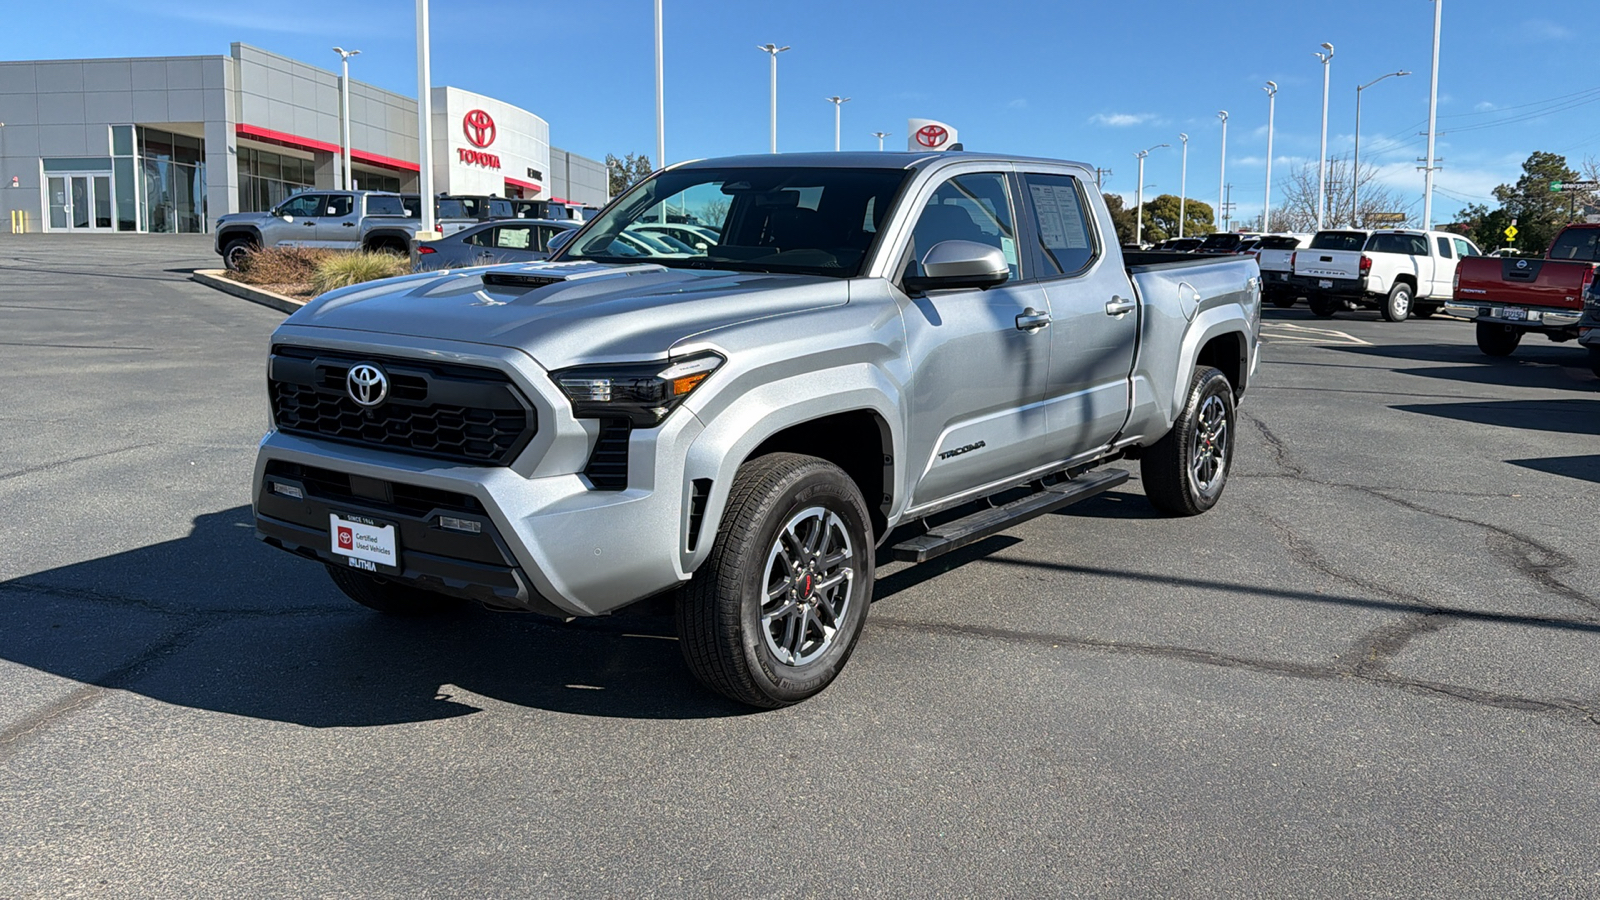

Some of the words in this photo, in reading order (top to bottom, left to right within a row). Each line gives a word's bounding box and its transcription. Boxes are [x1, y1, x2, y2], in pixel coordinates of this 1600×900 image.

[458, 148, 501, 170] TOYOTA
[938, 440, 986, 460] TACOMA
[347, 514, 362, 523] SINCE
[356, 533, 378, 543] Certified
[356, 543, 369, 551] Used
[370, 545, 391, 556] Vehicles
[355, 559, 377, 572] LITHIA
